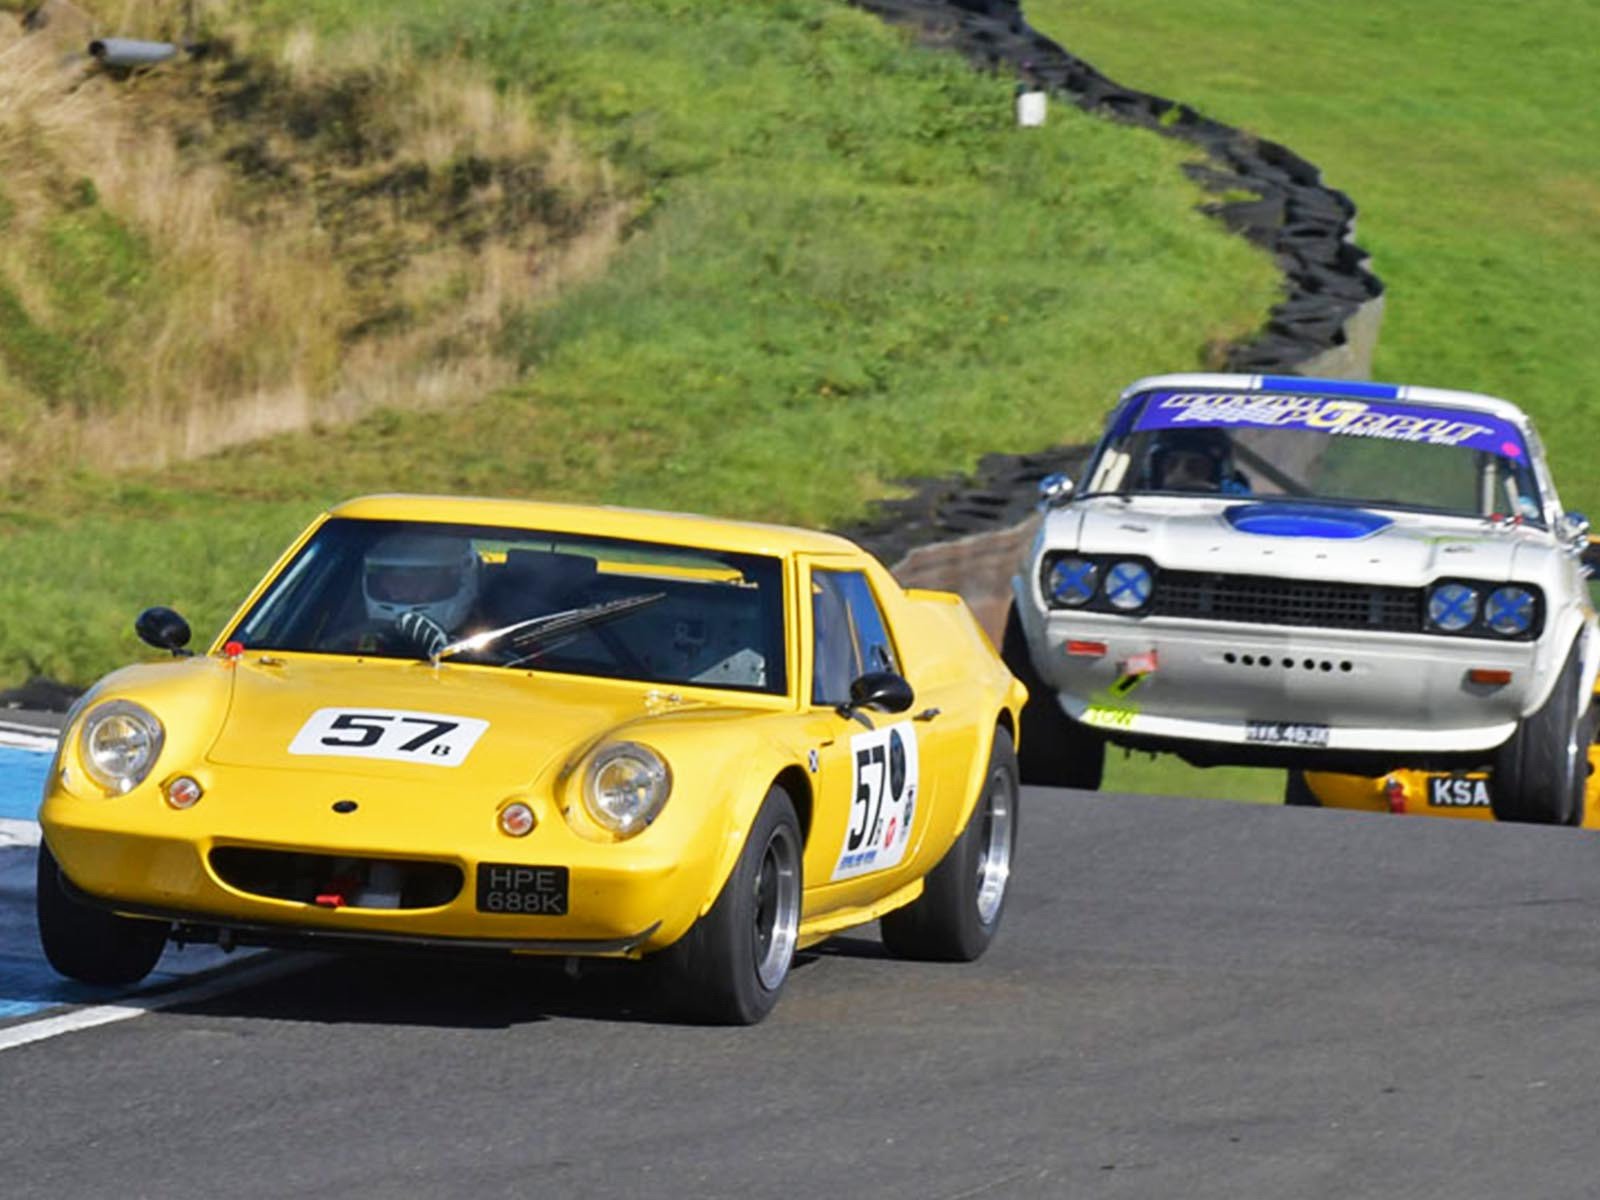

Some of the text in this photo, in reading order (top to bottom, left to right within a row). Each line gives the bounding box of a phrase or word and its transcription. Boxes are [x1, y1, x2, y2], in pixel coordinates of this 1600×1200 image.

[321, 713, 459, 752] 57
[848, 744, 886, 852] 57
[1433, 778, 1490, 806] KSA
[490, 869, 556, 892] HPE
[486, 891, 563, 913] 688K
